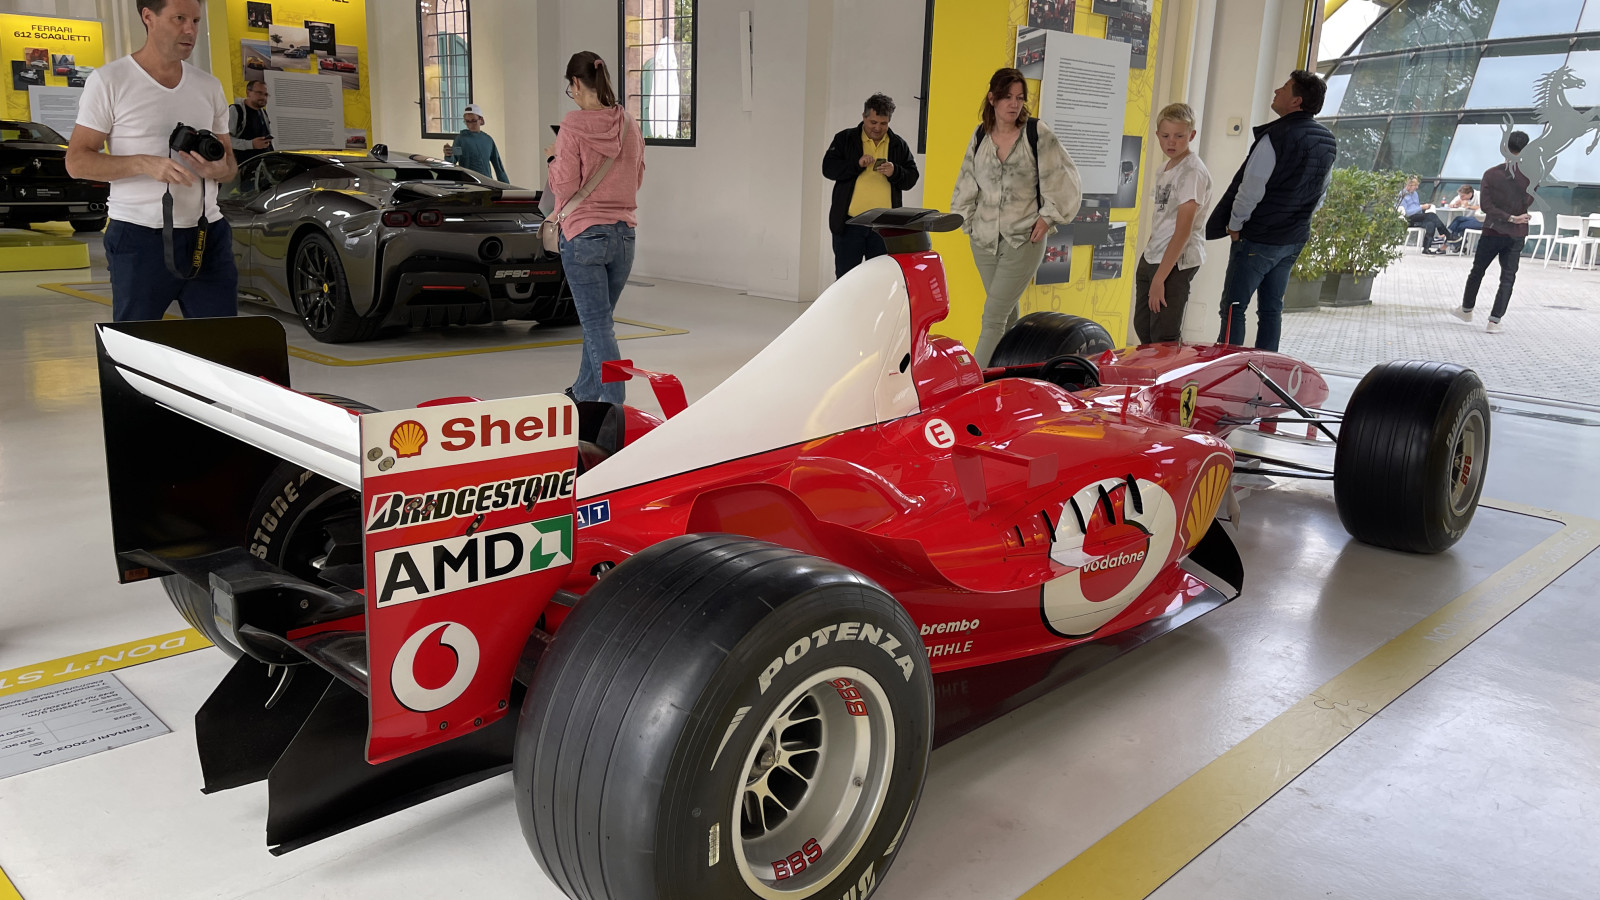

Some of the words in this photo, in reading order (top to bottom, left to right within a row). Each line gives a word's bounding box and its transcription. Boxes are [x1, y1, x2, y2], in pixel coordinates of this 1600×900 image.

[13, 30, 32, 39] 612
[34, 32, 91, 42] SCAGLIETTI
[31, 24, 72, 33] FERRARI
[494, 269, 531, 279] SF90
[440, 404, 573, 452] Shell
[929, 422, 952, 446] E
[366, 469, 576, 533] BRIDGESTONE
[378, 531, 524, 604] AMD
[1082, 549, 1145, 573] vodafone
[920, 618, 980, 636] brembo
[53, 636, 187, 677] DON'T
[757, 621, 916, 695] POTENZA
[826, 677, 869, 716] BBS
[98, 723, 150, 741] FERRARI
[770, 837, 822, 881] BBS
